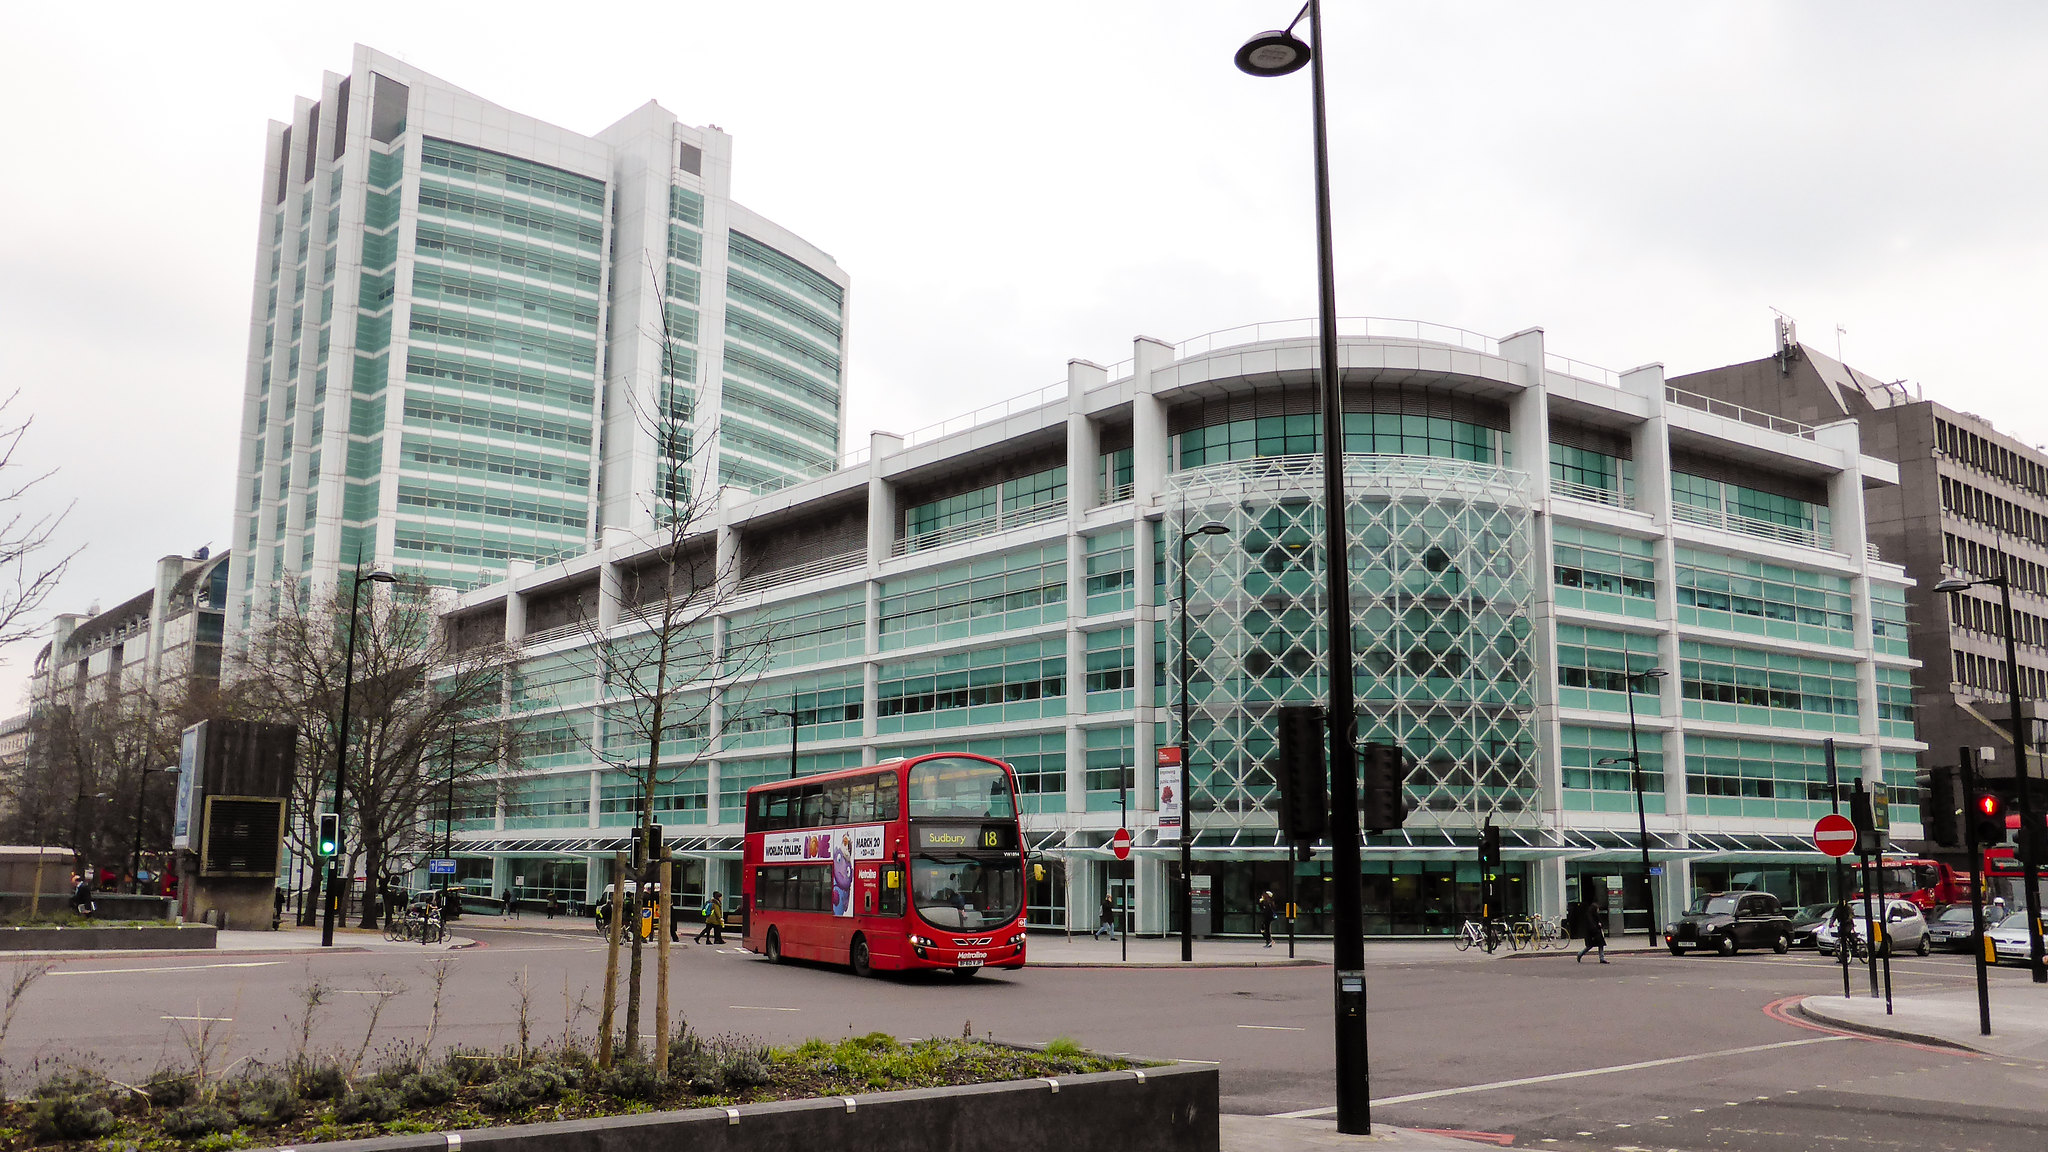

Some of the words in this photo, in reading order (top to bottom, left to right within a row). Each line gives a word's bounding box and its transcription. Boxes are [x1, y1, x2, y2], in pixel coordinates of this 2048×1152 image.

[856, 838, 873, 848] MARCH
[873, 837, 881, 848] 20
[929, 833, 966, 845] Sudbury
[984, 831, 998, 846] 18
[765, 846, 783, 856] WORLDS
[783, 845, 802, 856] COLLIDE
[858, 869, 877, 879] Metroline
[957, 951, 988, 959] Metroline
